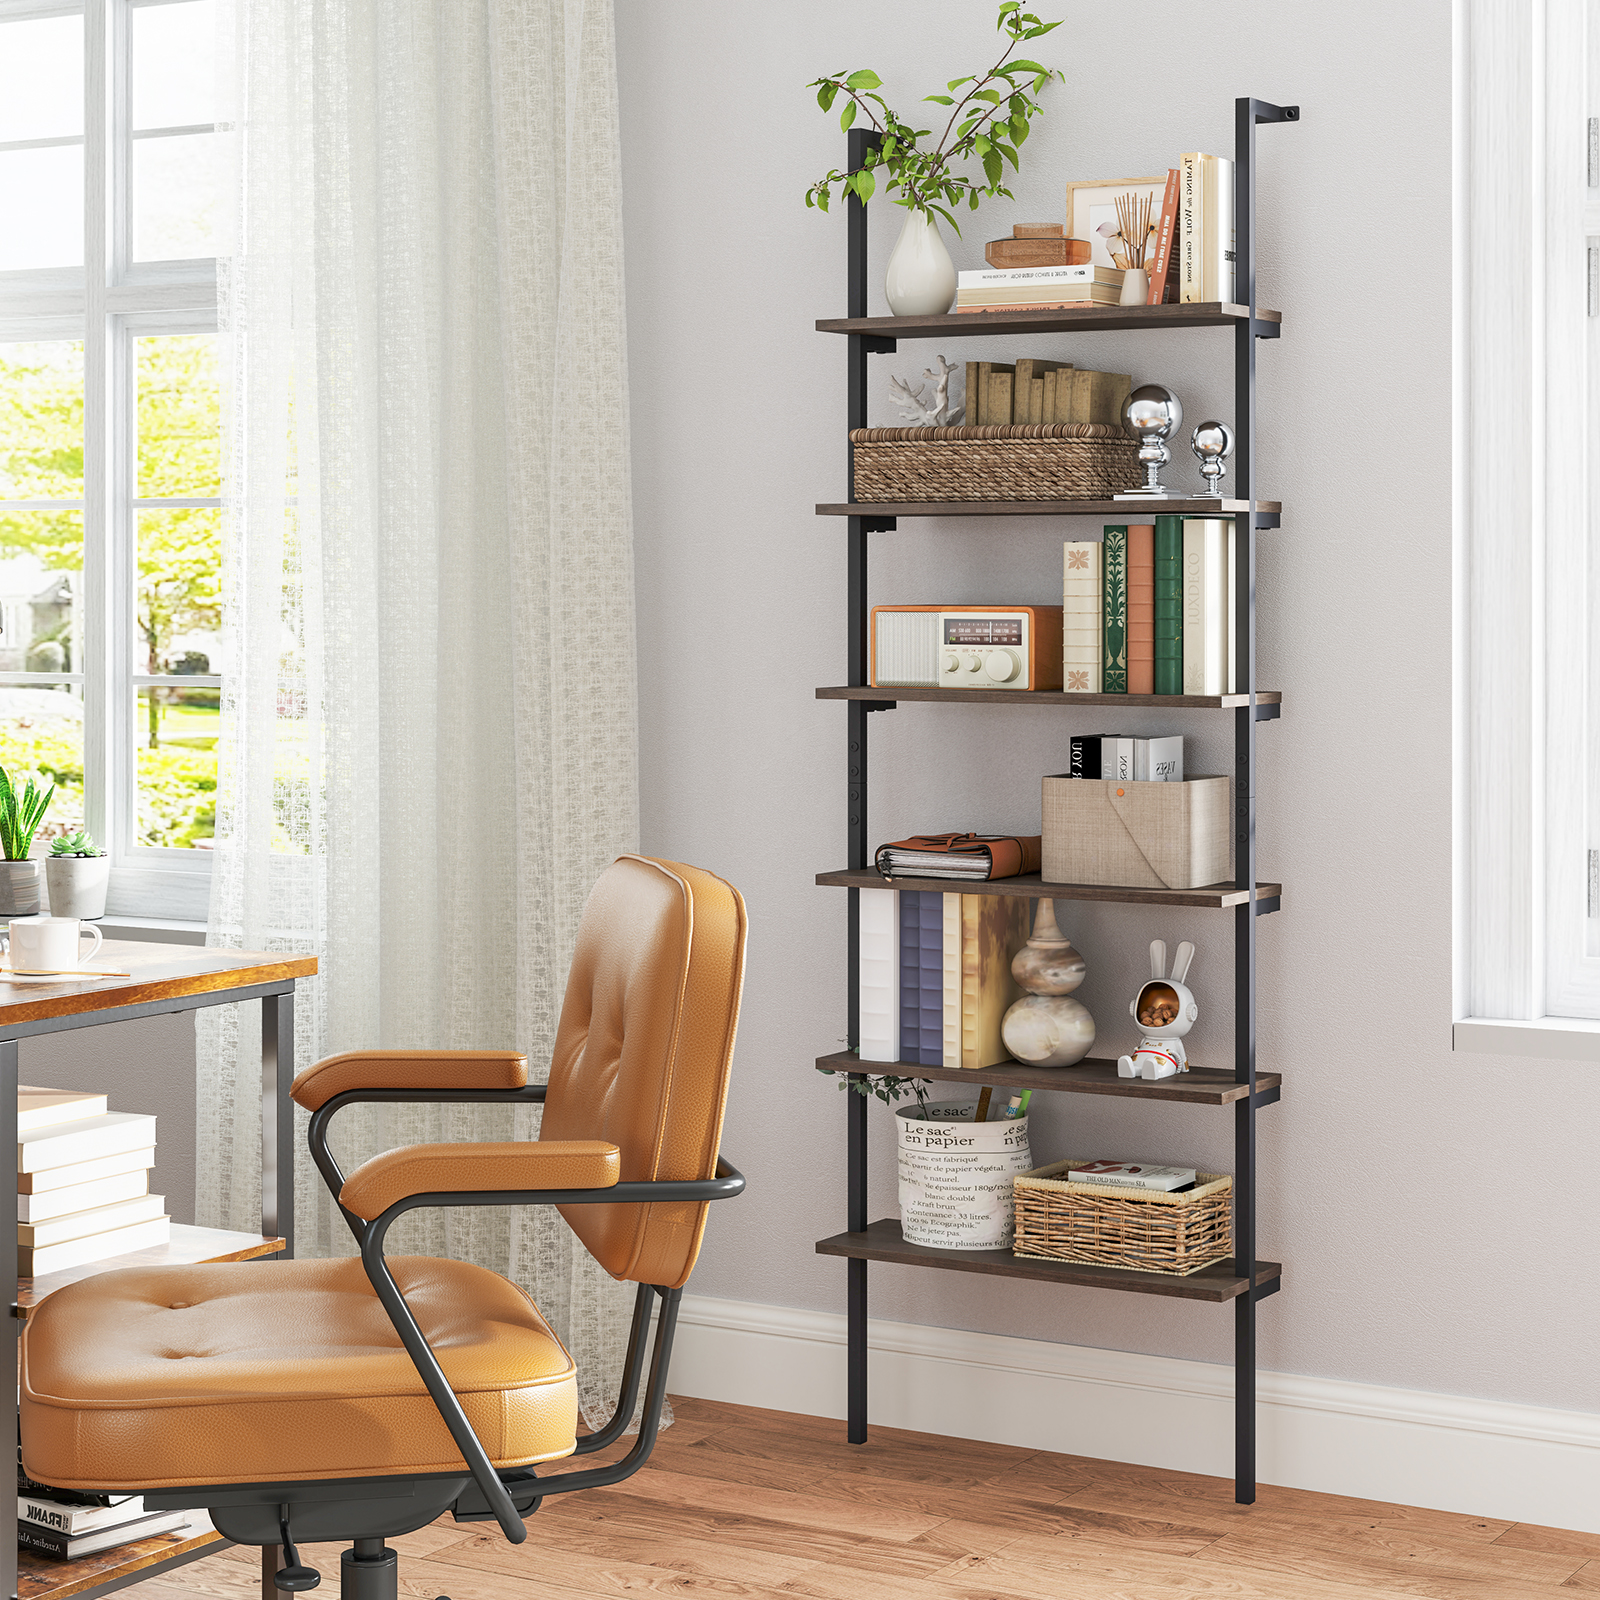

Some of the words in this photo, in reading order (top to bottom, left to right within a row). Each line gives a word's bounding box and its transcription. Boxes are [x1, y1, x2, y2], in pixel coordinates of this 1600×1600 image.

[1187, 552, 1200, 625] LUXDECO
[905, 1121, 924, 1134] Le
[905, 1135, 921, 1143] en
[925, 1136, 975, 1149] papier
[943, 1156, 979, 1164] fabriqué
[973, 1165, 1006, 1173] végétal.
[935, 1183, 972, 1192] épaisseur
[925, 1192, 946, 1200] blanc
[955, 1240, 993, 1248] plusieurs
